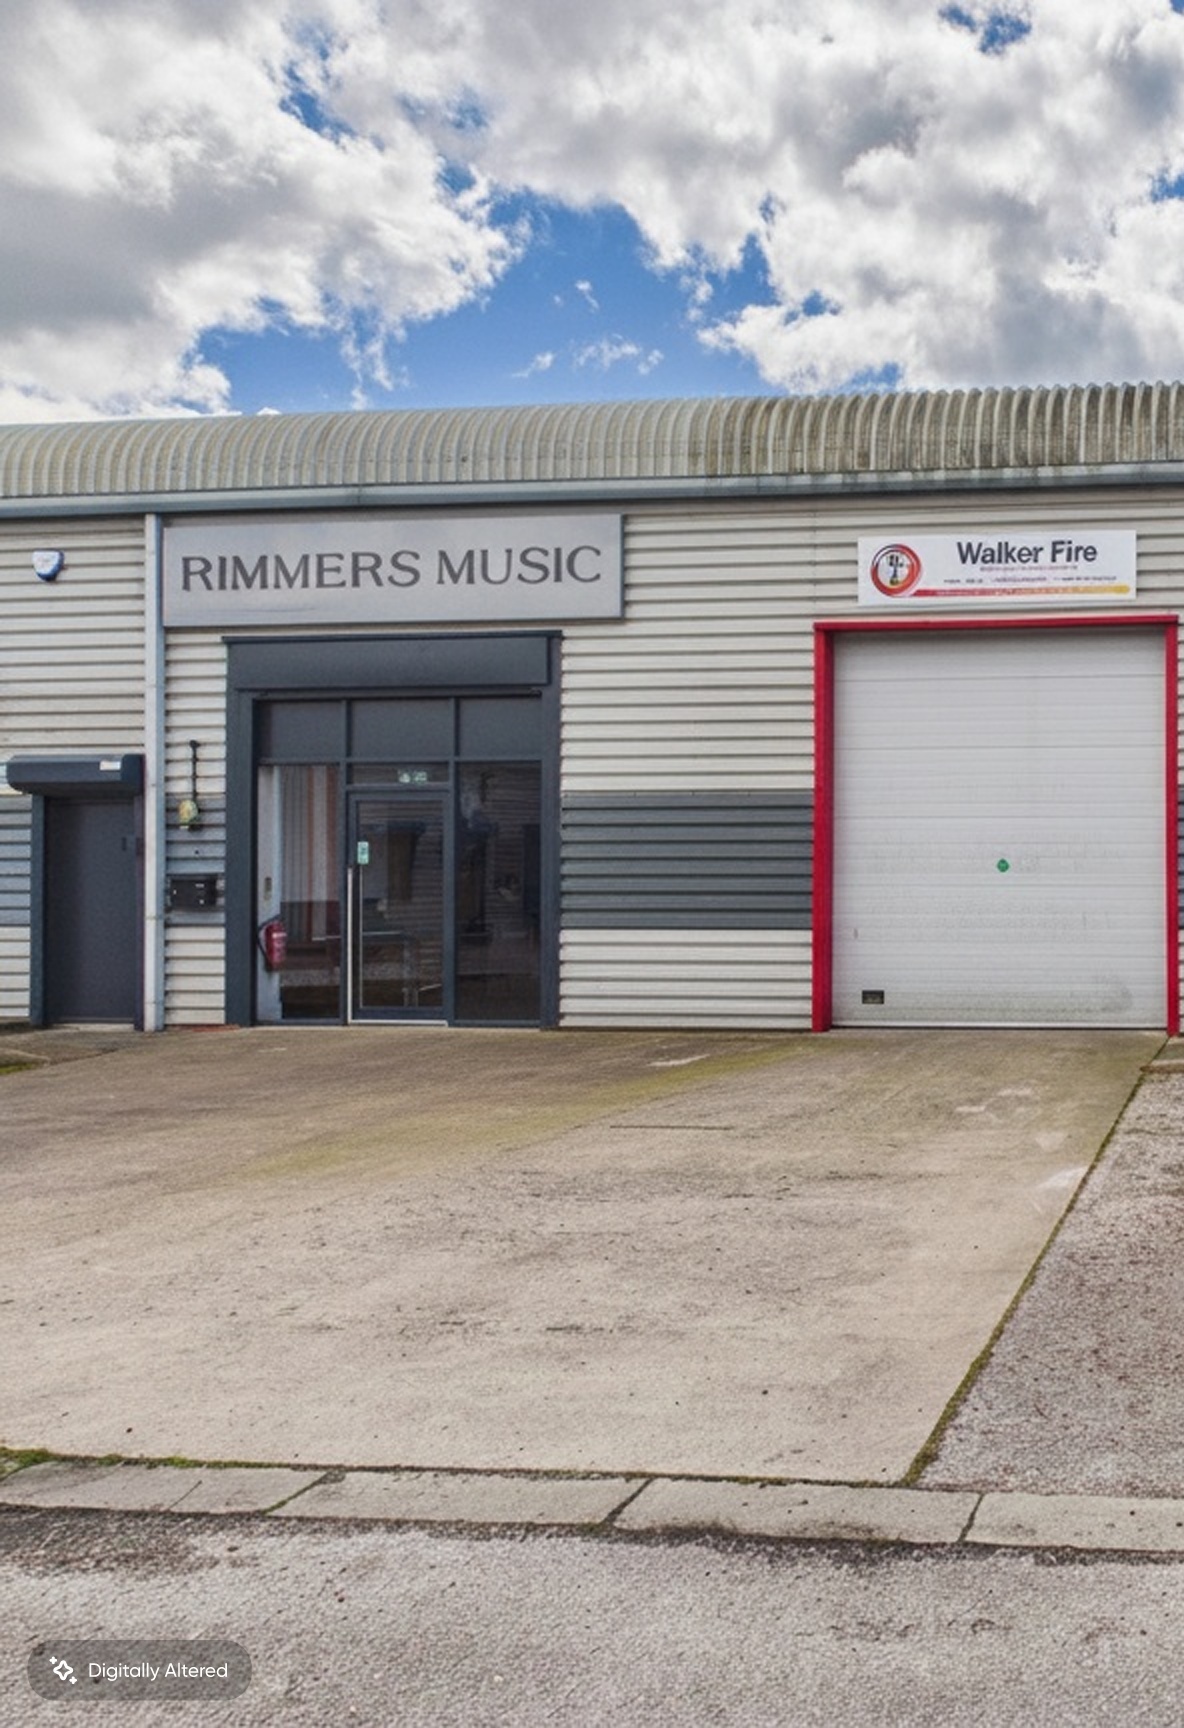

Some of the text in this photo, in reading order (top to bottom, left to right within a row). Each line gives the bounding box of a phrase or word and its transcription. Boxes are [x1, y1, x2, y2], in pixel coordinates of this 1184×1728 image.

[181, 545, 601, 592] RIMMERS MUSIC
[956, 540, 1098, 565] Walker Fire
